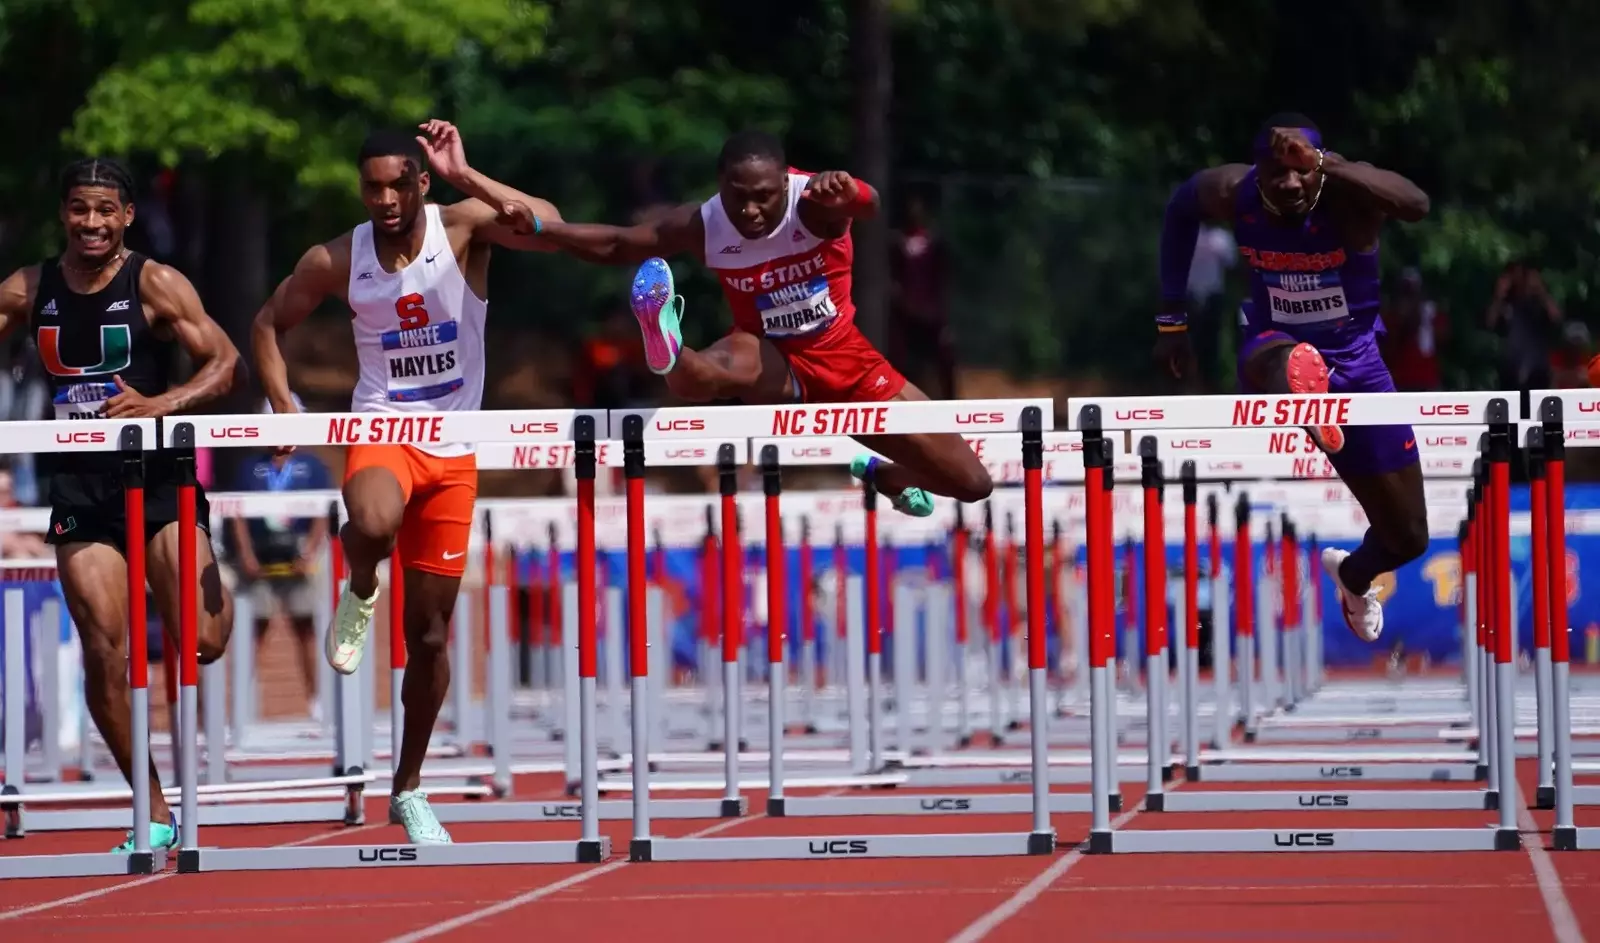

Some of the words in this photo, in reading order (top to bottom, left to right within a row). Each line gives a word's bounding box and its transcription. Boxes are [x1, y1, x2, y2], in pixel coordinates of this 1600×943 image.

[761, 253, 826, 289] STATE
[1280, 273, 1322, 292] UNITE
[769, 281, 813, 306] UNITE
[106, 300, 130, 311] ACC
[1272, 295, 1344, 314] ROBERTS
[765, 297, 830, 329] MURRAY
[398, 325, 442, 348] UNITE
[390, 350, 456, 379] HAYLES
[1116, 409, 1164, 420] UCS
[1232, 400, 1268, 426] NC
[1274, 398, 1352, 425] STATE
[1420, 405, 1470, 416] UCS
[772, 410, 807, 436] NC
[812, 408, 889, 434] STATE
[956, 412, 1004, 424] UCS
[327, 418, 362, 443] NC
[368, 417, 443, 442] STATE
[511, 423, 558, 434] UCS
[656, 420, 705, 431] UCS
[57, 432, 105, 443] UCS
[210, 427, 259, 438] UCS
[1171, 439, 1212, 449] UCS
[1269, 433, 1298, 454] NC
[1426, 436, 1467, 446] UCS
[513, 445, 541, 468] NC
[547, 444, 608, 467] STE
[665, 449, 705, 459] UCS
[791, 447, 832, 458] UCS
[1320, 767, 1363, 777] UCS
[920, 799, 970, 810] UCS
[1298, 795, 1349, 807] UCS
[1274, 833, 1334, 847] UCS
[809, 840, 868, 854] UCS
[359, 848, 417, 862] UCS
